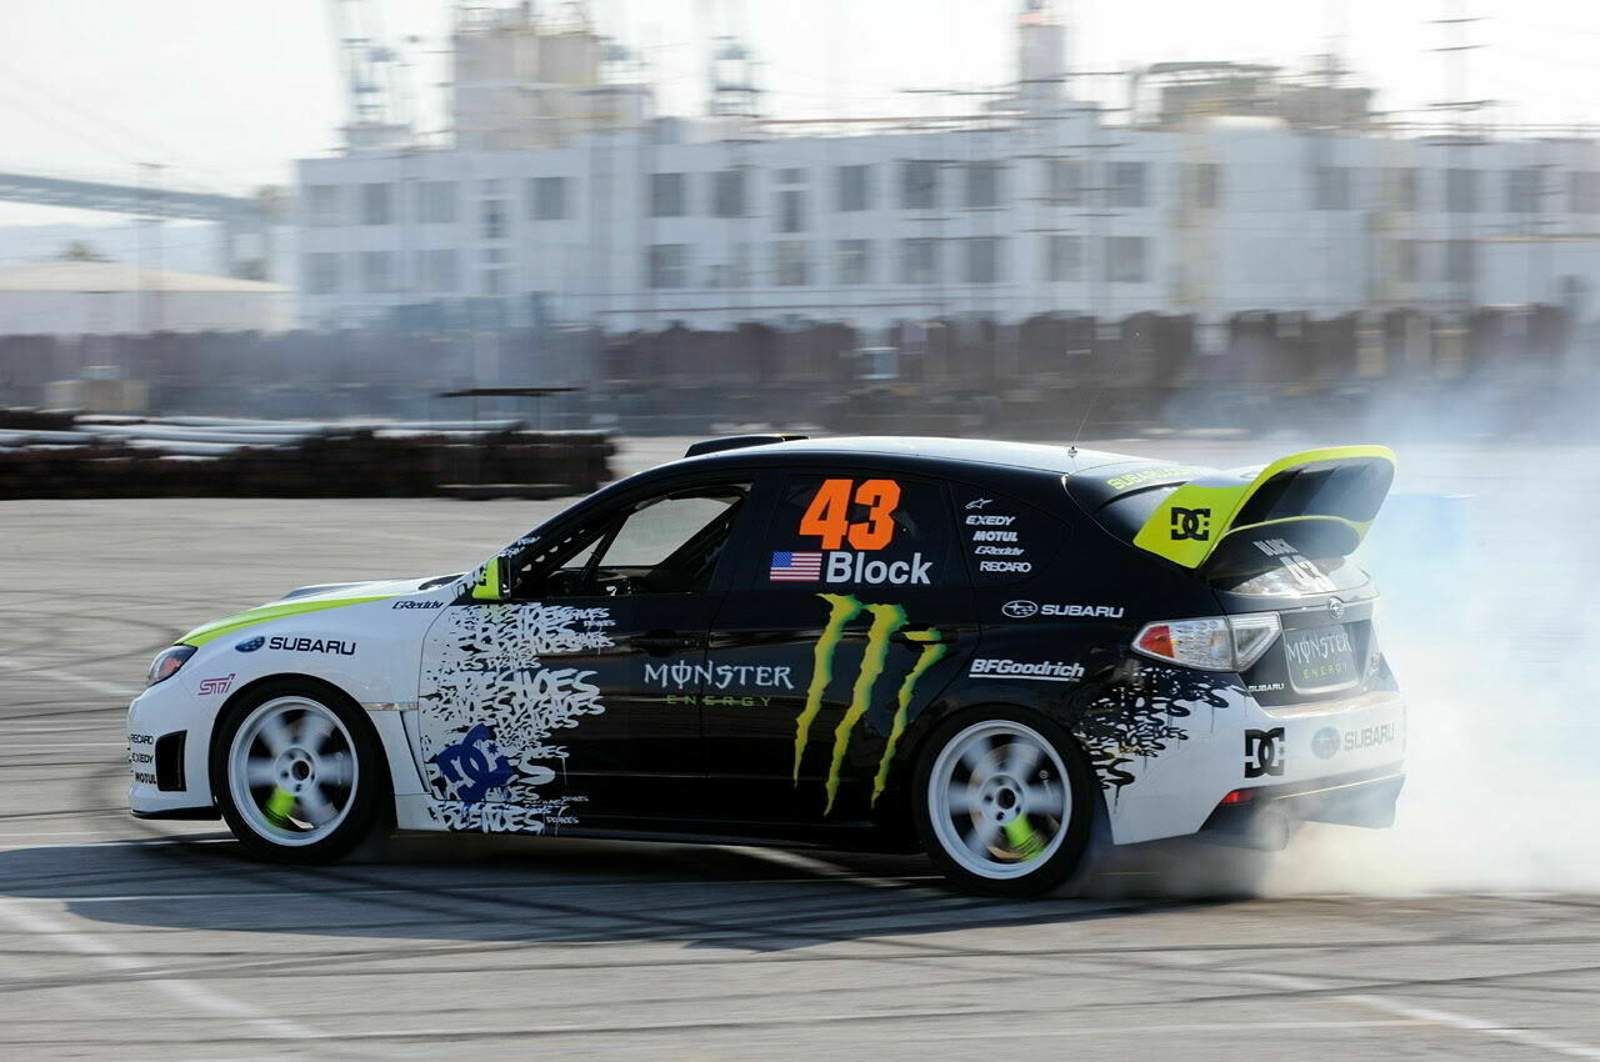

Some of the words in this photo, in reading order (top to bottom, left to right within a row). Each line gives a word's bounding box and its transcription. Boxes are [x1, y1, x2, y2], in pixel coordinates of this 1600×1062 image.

[799, 479, 901, 550] 43
[966, 515, 1016, 526] EXEDY
[1171, 507, 1211, 541] DC
[973, 530, 1018, 542] MOTUL
[826, 551, 933, 585] Block
[980, 560, 1032, 573] RECARO
[1041, 604, 1125, 619] SUBARU
[269, 636, 356, 656] SUBARU
[644, 659, 794, 690] MONSTER
[970, 658, 1085, 678] BFGoodrich
[1248, 683, 1285, 693] SUBARU
[666, 694, 772, 707] ENERGY
[1344, 724, 1396, 752] SUBARU
[1244, 727, 1285, 778] DC
